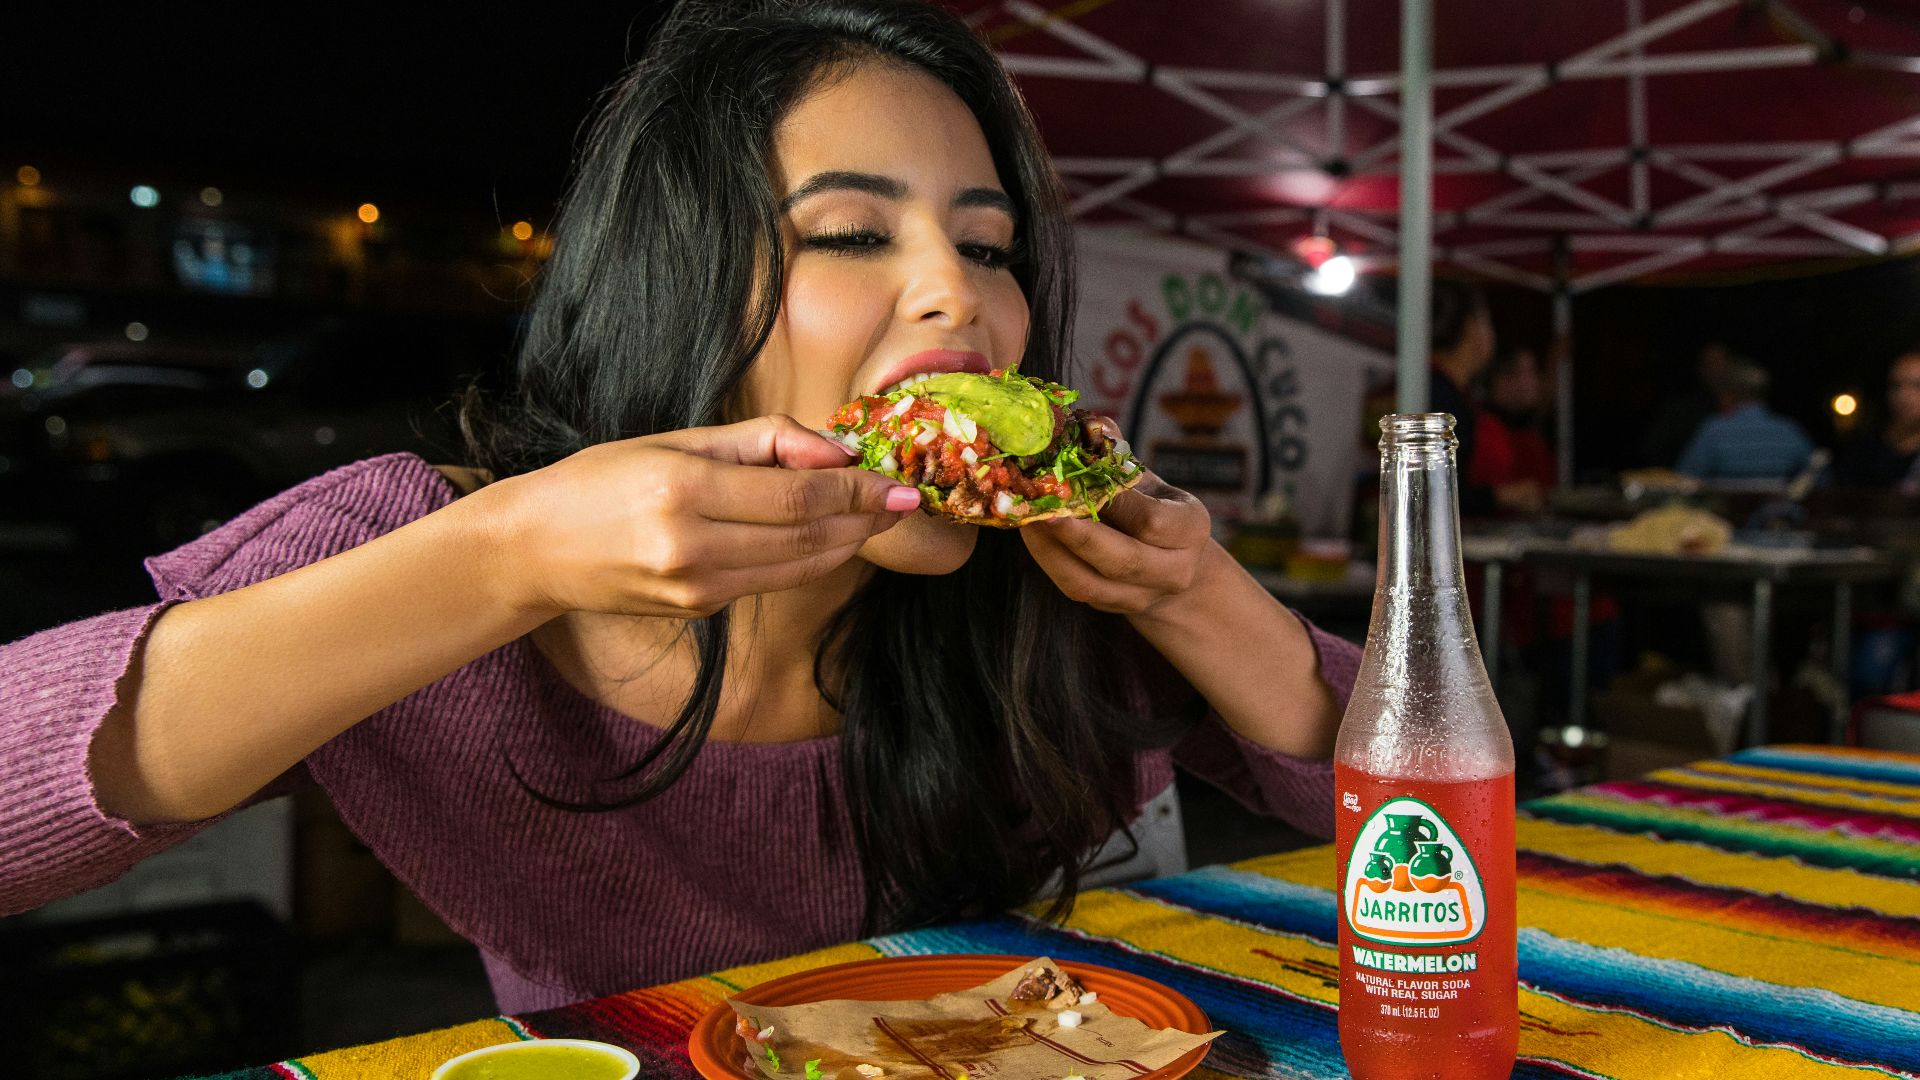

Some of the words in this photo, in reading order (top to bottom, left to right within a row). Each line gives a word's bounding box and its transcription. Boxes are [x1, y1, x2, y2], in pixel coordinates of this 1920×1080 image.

[1091, 298, 1160, 419] COS
[1161, 272, 1261, 337] DON
[1360, 896, 1460, 924] JARRITOS
[1351, 945, 1478, 974] WATERMELON
[1355, 971, 1395, 989] NATURAL
[1397, 979, 1439, 990] FLAVOR
[1442, 979, 1471, 990] SODA
[1365, 983, 1389, 997] WITH
[1391, 989, 1419, 1001] REAL
[1421, 990, 1458, 1000] SUGAR
[1402, 1004, 1419, 1018] (12.5
[1419, 1007, 1428, 1019] FL
